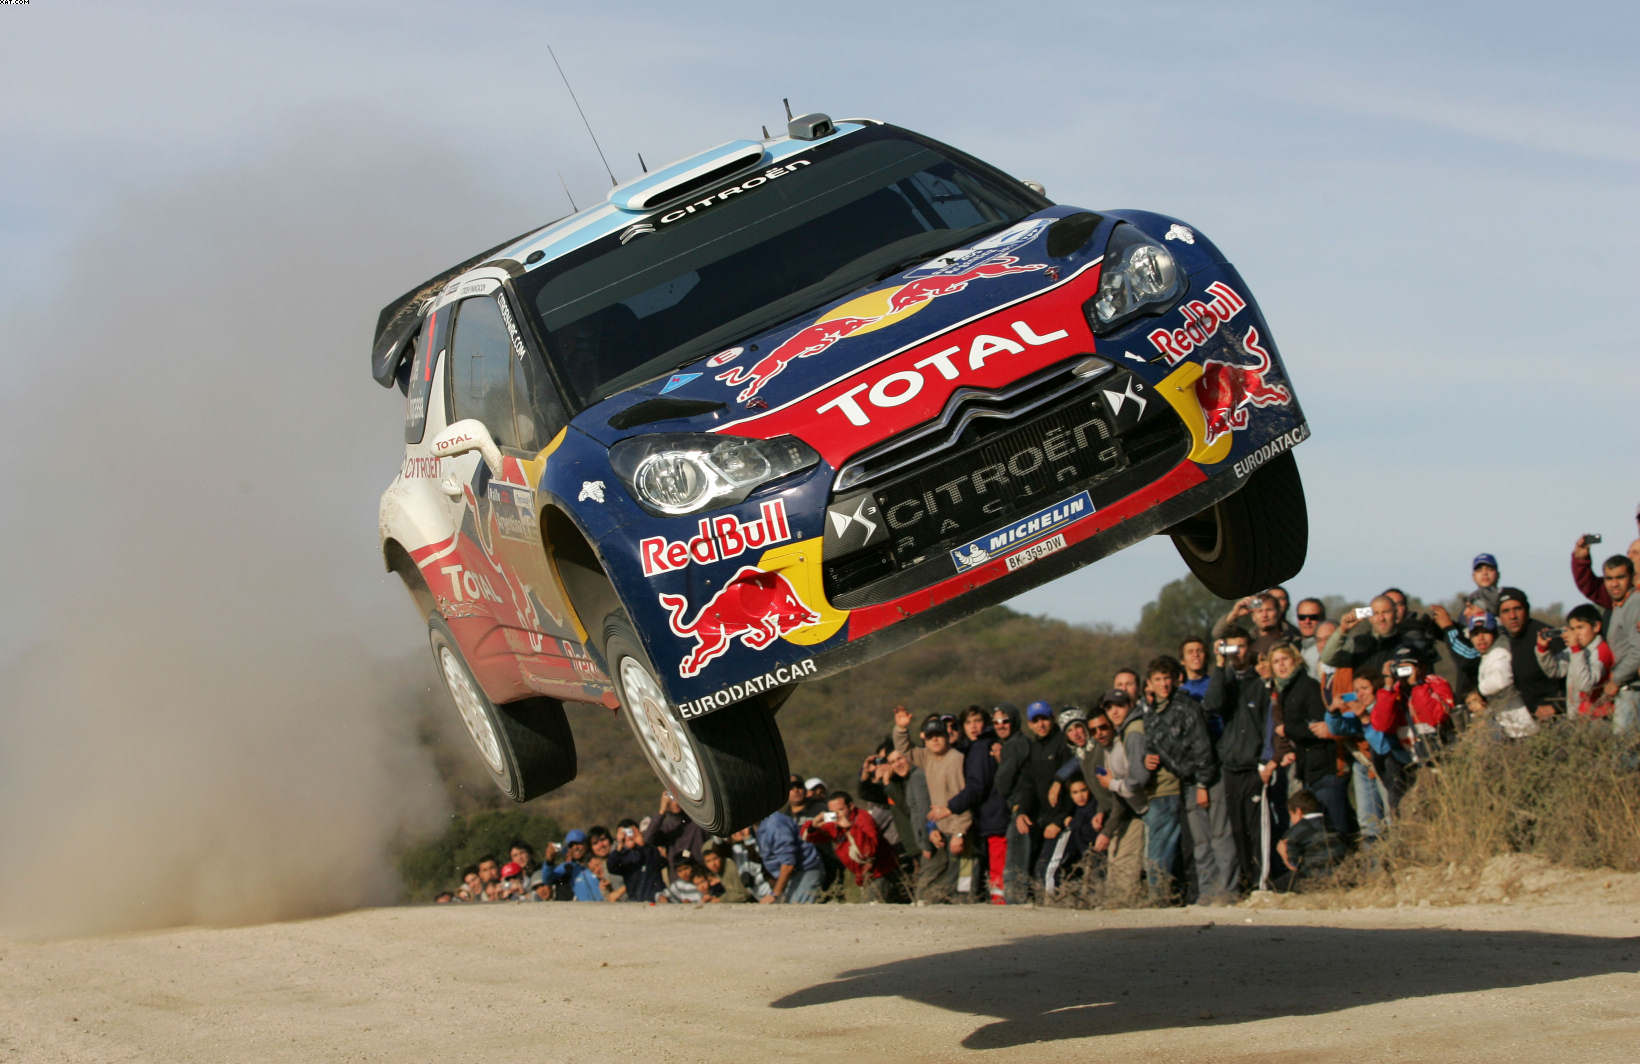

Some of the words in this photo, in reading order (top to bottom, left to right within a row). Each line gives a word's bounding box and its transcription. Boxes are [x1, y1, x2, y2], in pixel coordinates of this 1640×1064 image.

[816, 320, 1068, 427] TOTAL
[436, 433, 473, 451] TOTAL
[989, 498, 1084, 551] MICHELIN
[1008, 536, 1062, 568] BK-359-DW
[441, 564, 504, 604] TOTAL
[678, 658, 818, 719] EURODATACAR
